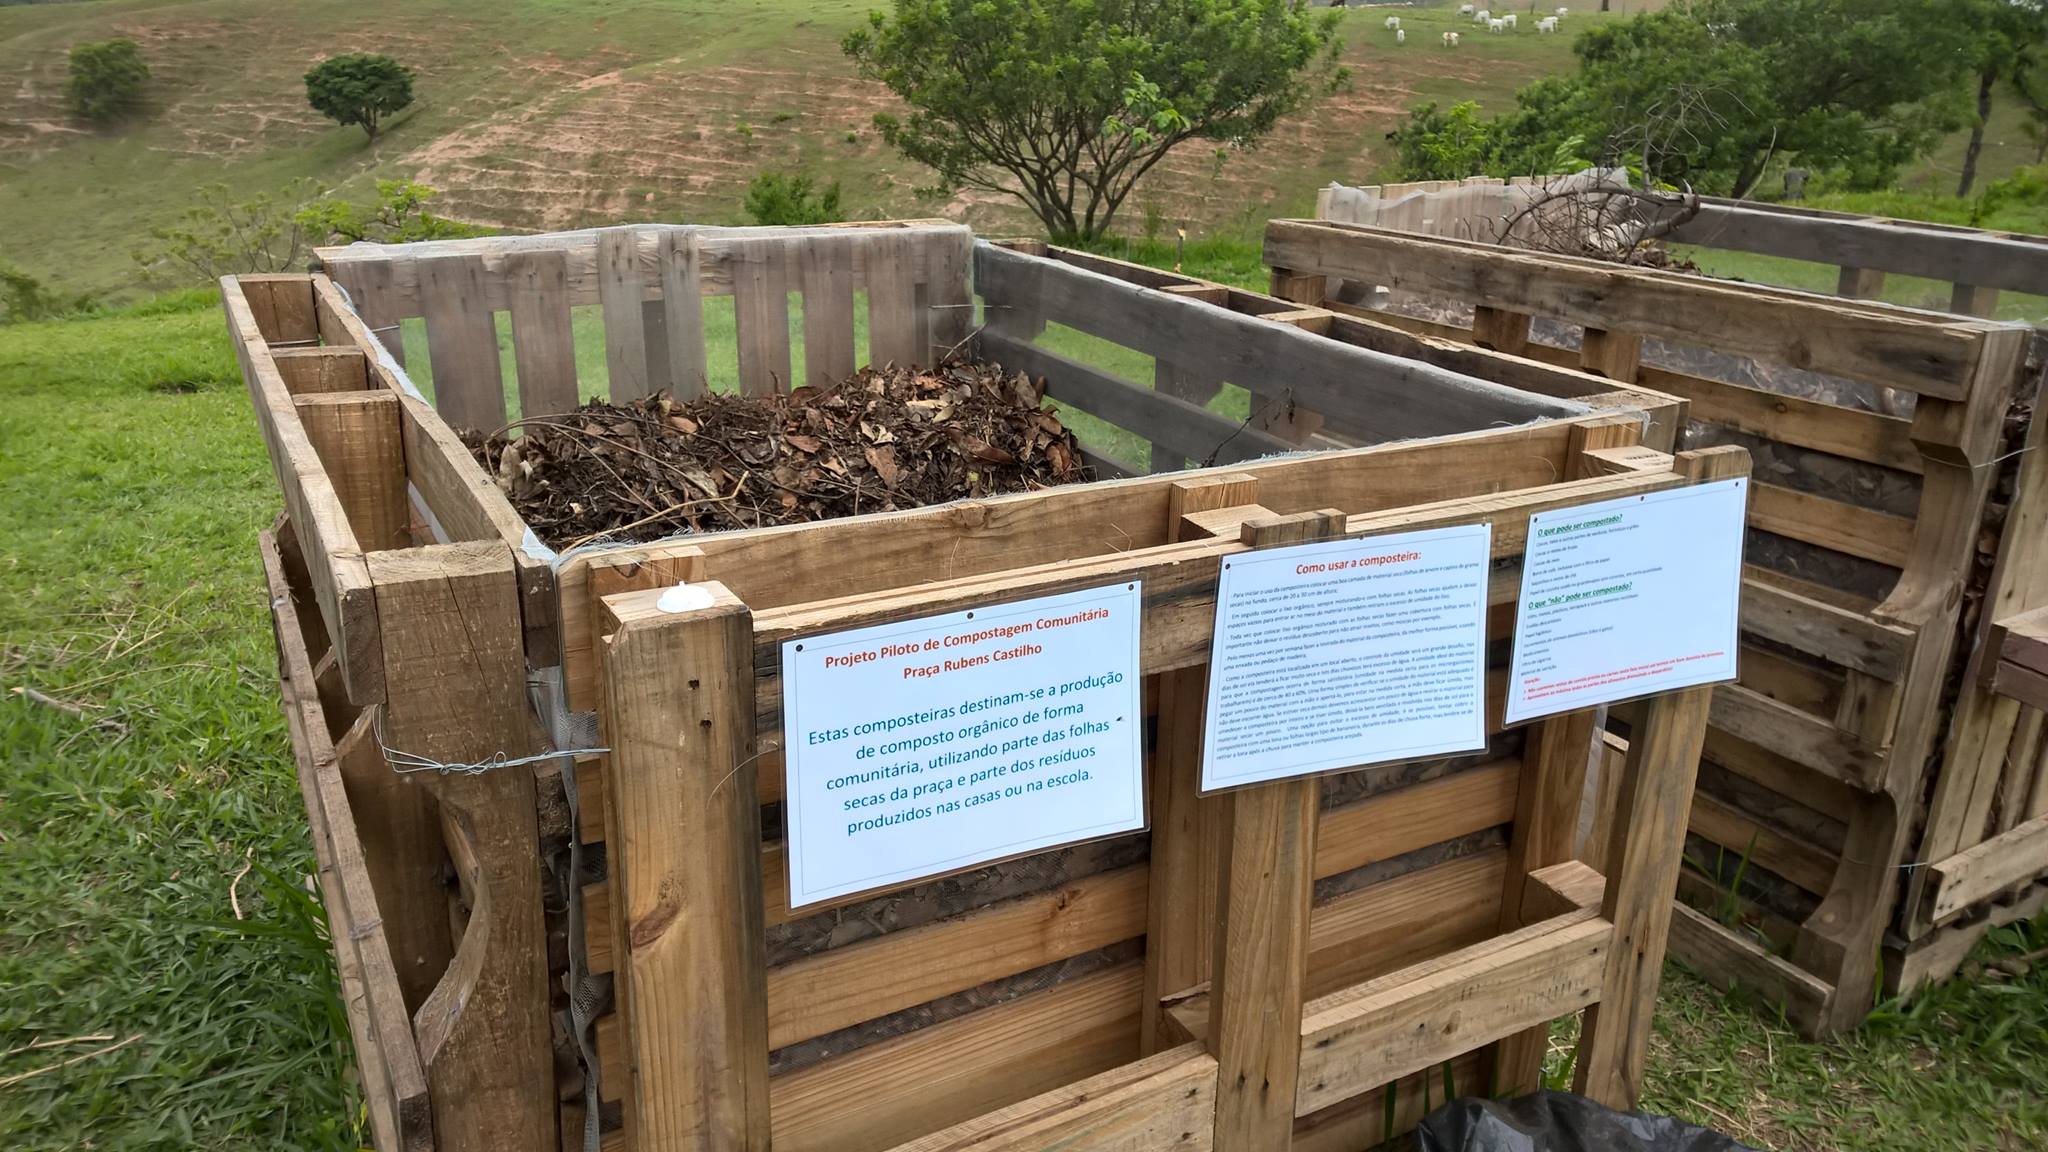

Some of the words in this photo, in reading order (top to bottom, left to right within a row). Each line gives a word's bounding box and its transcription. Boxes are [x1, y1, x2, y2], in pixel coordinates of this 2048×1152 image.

[1543, 528, 1554, 537] que
[1555, 523, 1573, 535] pode
[1582, 514, 1624, 528] compostado?
[1296, 564, 1326, 575] Como
[1328, 560, 1349, 571] usar
[1351, 559, 1357, 568] a
[1359, 551, 1422, 567] composteira:
[1534, 599, 1547, 610] que
[1565, 591, 1582, 604] pode
[1581, 591, 1592, 599] ser
[1592, 581, 1633, 597] compostado?
[825, 651, 877, 669] Projeto
[881, 643, 920, 659] Piloto
[923, 638, 940, 651] de
[943, 623, 1033, 648] Compostagem
[1036, 607, 1109, 630] Comunitária
[904, 665, 940, 679] Praça
[944, 654, 990, 672] Rubens
[993, 644, 1042, 662] Castilho
[809, 727, 849, 745] Estas
[853, 707, 956, 736] composteiras
[959, 688, 1044, 715] destinam-se
[1048, 686, 1056, 696] a
[1060, 671, 1123, 697] produção
[856, 745, 875, 760] de
[880, 731, 954, 755] composto
[958, 717, 1019, 739] orgânico
[1022, 711, 1040, 725] de
[1043, 703, 1084, 720] forma
[826, 761, 923, 790] comunitária,
[928, 743, 998, 769] utilizando
[1002, 736, 1039, 755] parte
[1042, 729, 1066, 744] das
[1069, 721, 1110, 738] folhas
[844, 793, 886, 811] secas
[890, 787, 908, 801] da
[913, 779, 953, 800] praça
[957, 776, 966, 786] e
[970, 766, 1007, 786] parte
[1010, 759, 1035, 773] dos
[1039, 747, 1096, 767] resíduos
[848, 807, 932, 837] produzidos
[936, 800, 961, 815] nas
[964, 790, 1001, 808] casas
[1004, 785, 1022, 798] ou
[1026, 780, 1043, 792] na
[1047, 769, 1093, 788] escola.
